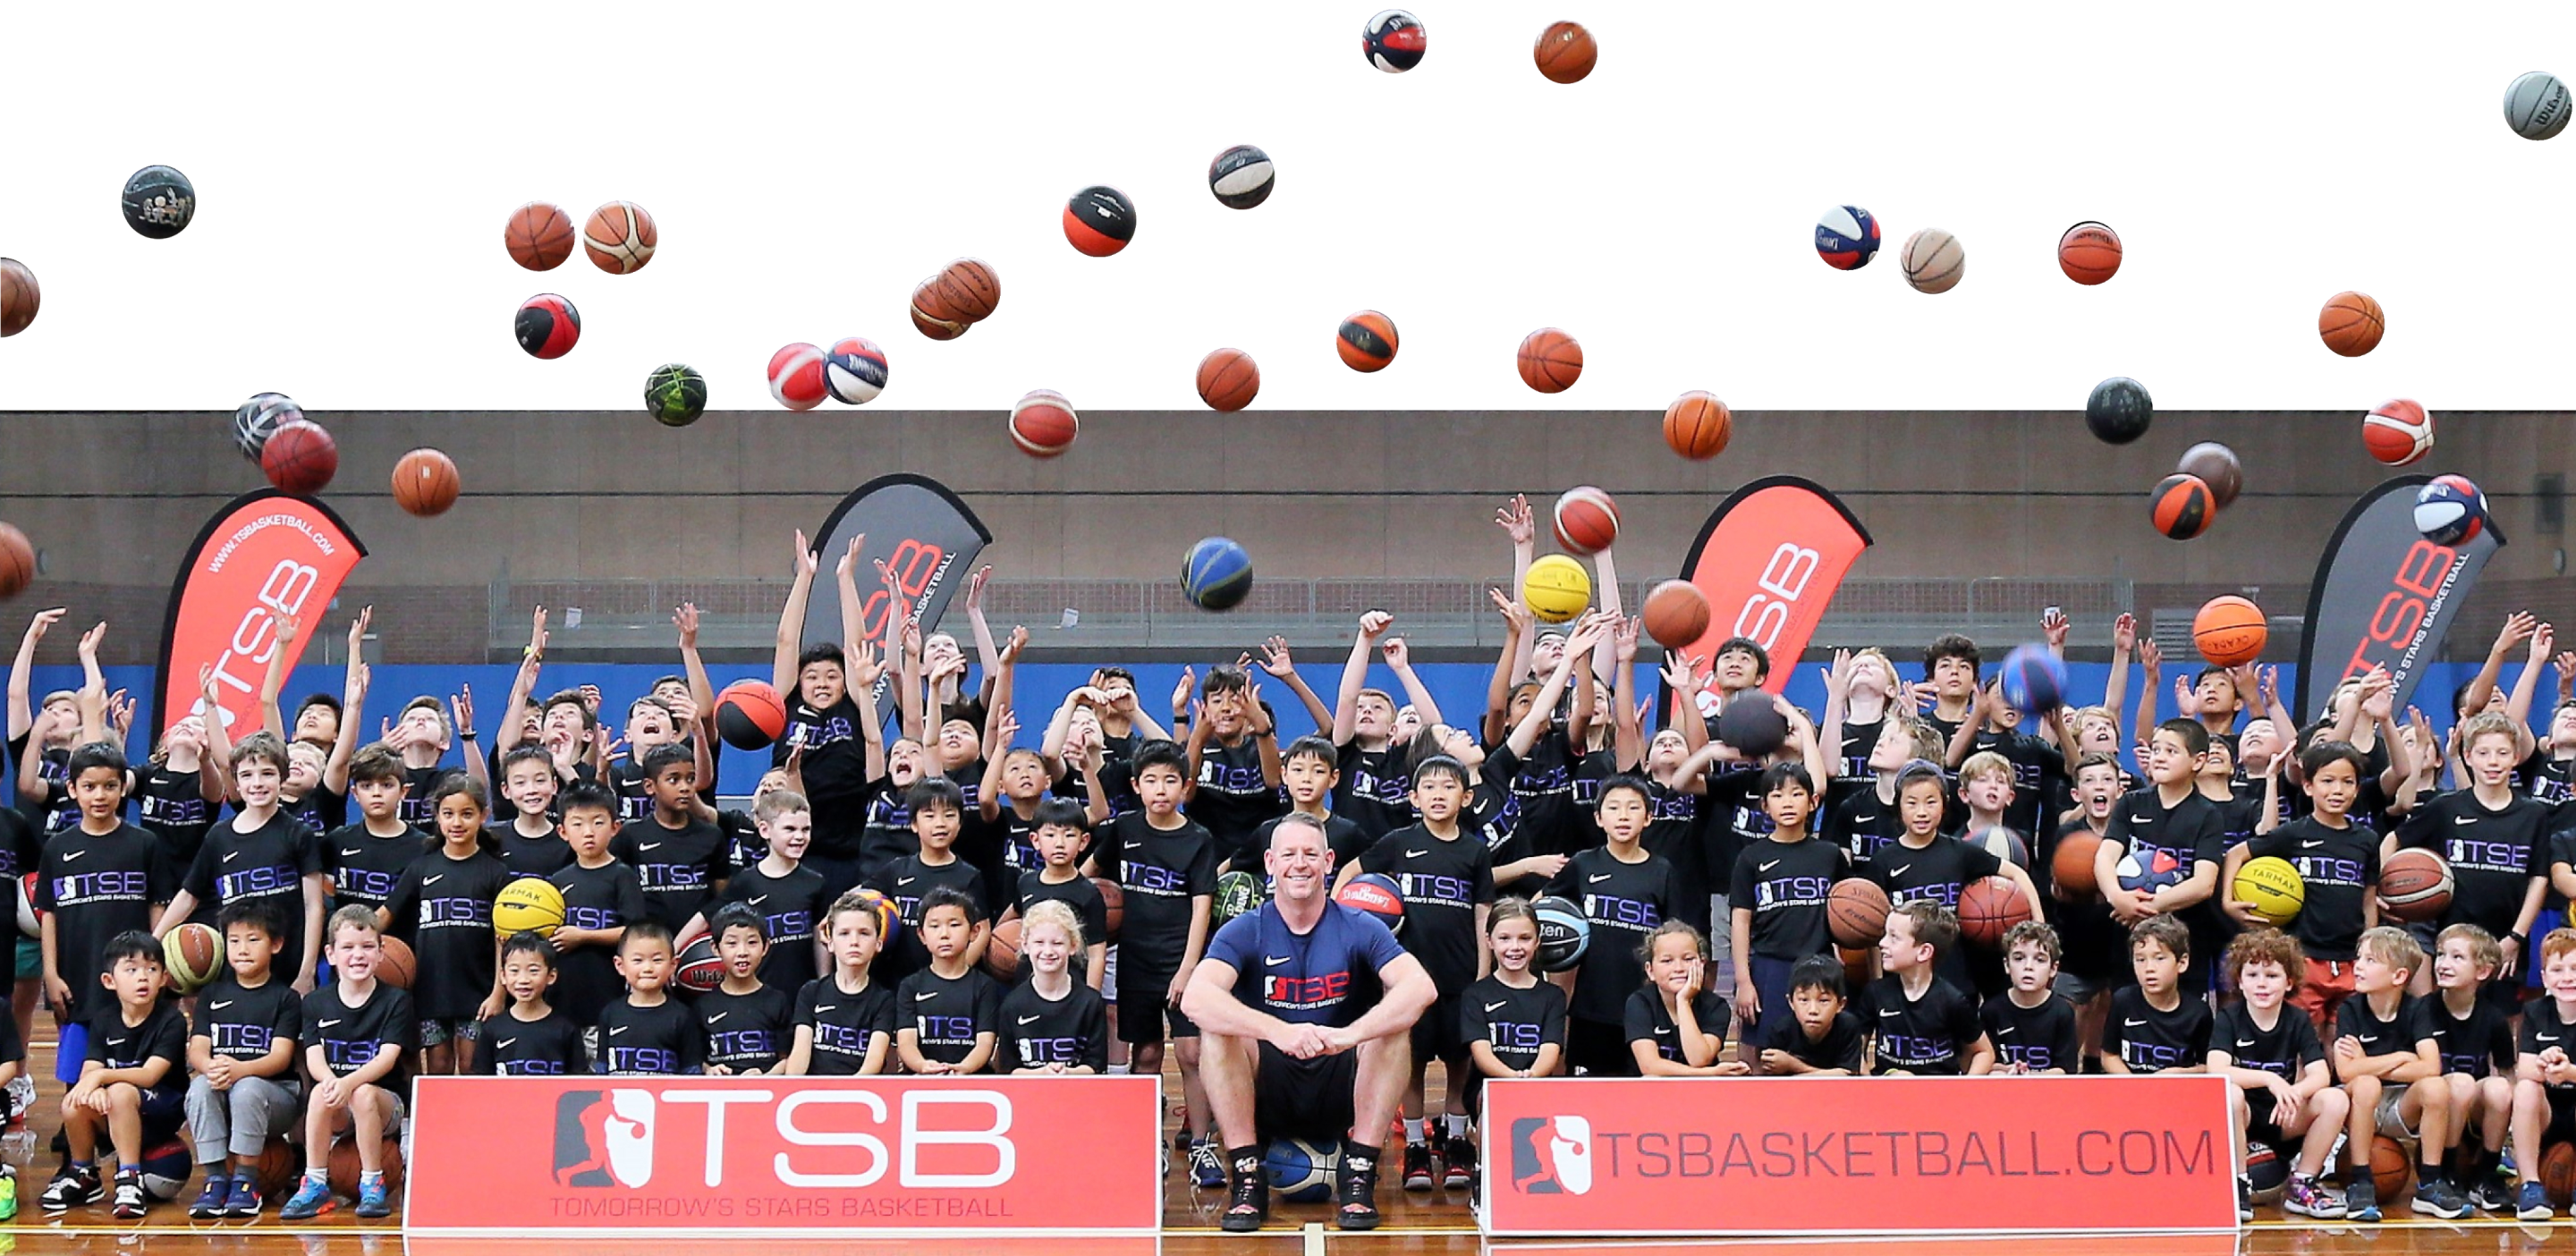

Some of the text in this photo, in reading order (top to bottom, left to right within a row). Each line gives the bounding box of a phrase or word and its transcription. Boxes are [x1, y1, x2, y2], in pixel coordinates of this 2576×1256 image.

[208, 514, 335, 573] WWW.TSBASKETBALL.COM
[861, 539, 943, 649] SB
[1733, 542, 1819, 652] SB
[2343, 539, 2456, 683] TSB
[2402, 552, 2470, 673] STARS BASKETBALL
[210, 559, 319, 694] TSB
[2466, 840, 2530, 869] TSB
[75, 871, 148, 895] TSB
[230, 863, 300, 894] TSB
[348, 868, 400, 895] TS
[2253, 868, 2296, 893] TARMAK
[432, 897, 492, 922] TSB
[1597, 895, 1662, 928] TSB
[1539, 923, 1565, 938] ten
[691, 969, 725, 984] Wils
[1286, 972, 1351, 1003] TSB
[927, 1015, 972, 1038] TS
[1496, 1023, 1540, 1047] TS
[2007, 1045, 2051, 1069] TS
[660, 1089, 1016, 1188] TSB
[1597, 1130, 2215, 1177] TSBASKETBALL.COM
[551, 1198, 1014, 1217] TOMORROW'S STARS BASKETBALL
